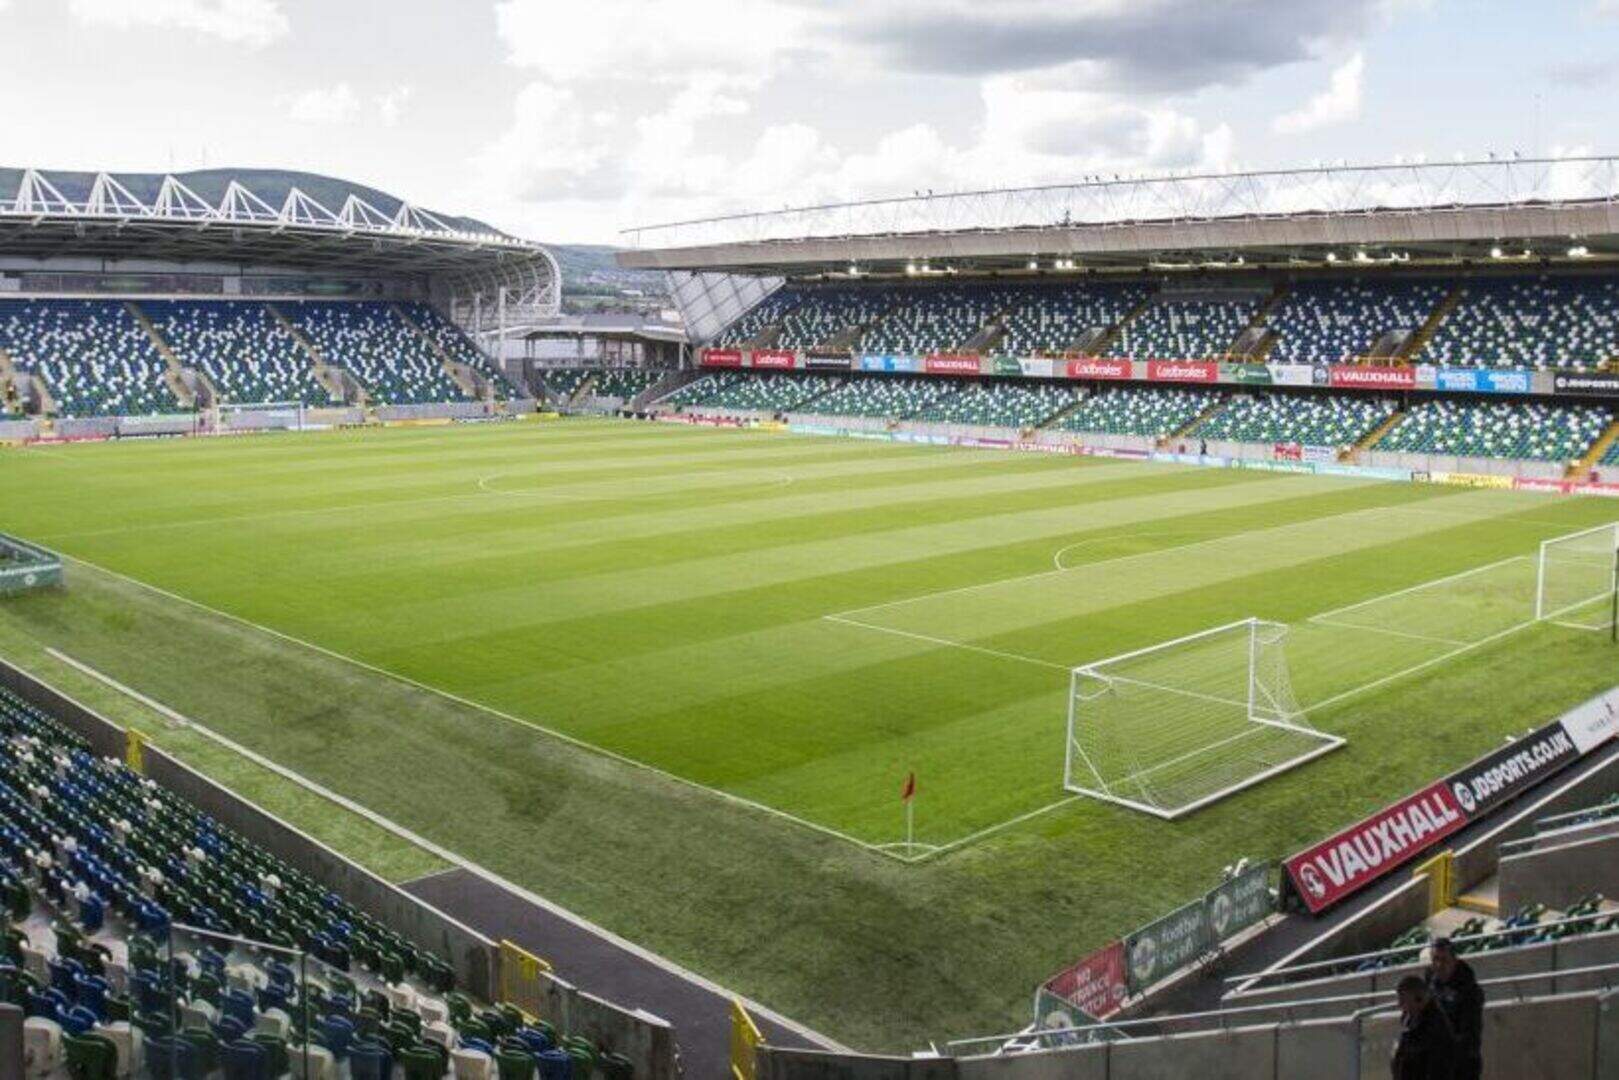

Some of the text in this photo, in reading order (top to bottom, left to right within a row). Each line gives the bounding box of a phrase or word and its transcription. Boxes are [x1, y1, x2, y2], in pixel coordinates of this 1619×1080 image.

[1075, 362, 1122, 376] Ladbrokes
[1156, 365, 1207, 379] Ladbrokes
[1342, 371, 1414, 384] VAUXHALL
[1470, 731, 1575, 800] JDSPORTS.CO.UK
[1314, 792, 1459, 887] VAUXHALL
